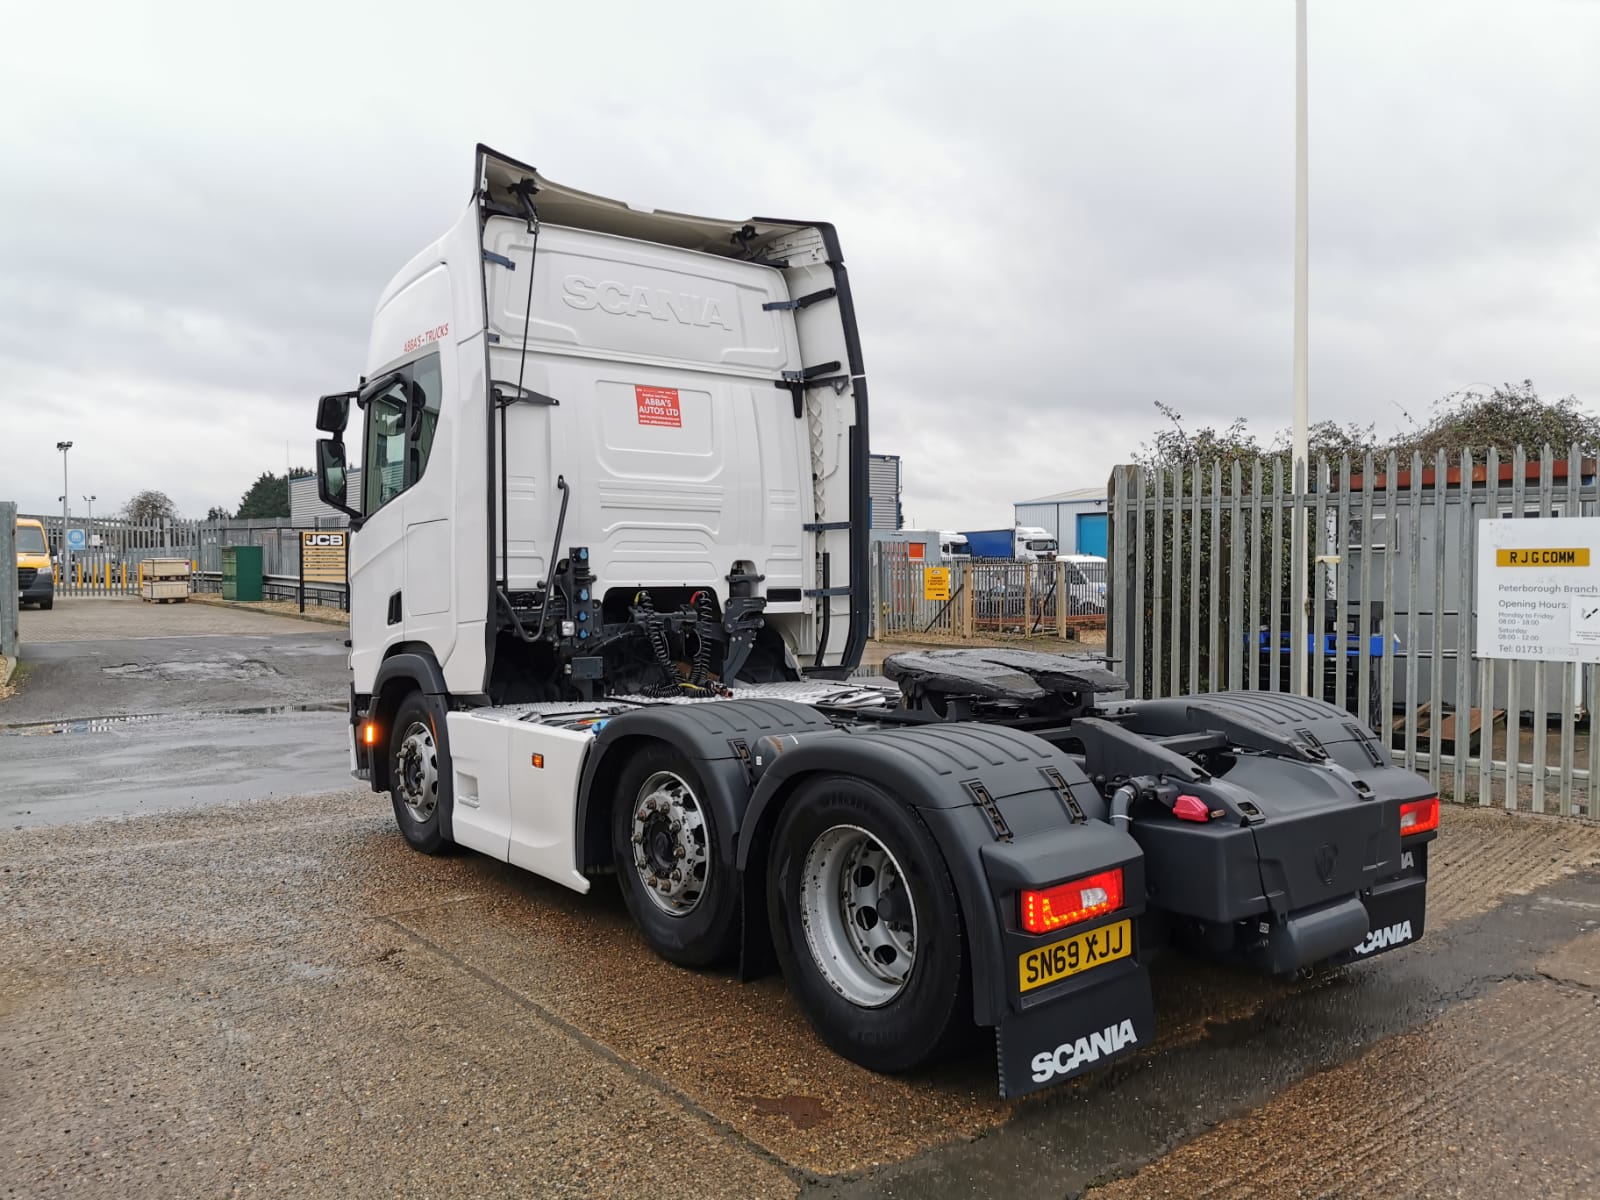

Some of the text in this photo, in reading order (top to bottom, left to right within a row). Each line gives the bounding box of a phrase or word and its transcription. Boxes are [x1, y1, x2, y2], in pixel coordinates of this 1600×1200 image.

[562, 274, 733, 332] SCANIA
[425, 323, 449, 343] TRUCKS
[645, 398, 672, 407] ABBA'S
[639, 405, 679, 416] AUTOS LTD
[305, 534, 343, 546] JCB
[1498, 584, 1598, 594] Peterborough Branch
[1498, 599, 1569, 609] Opening Hours:
[1498, 627, 1527, 635] Saturday
[1515, 645, 1543, 654] 01733
[1026, 926, 1123, 983] SN69 XJJ
[1031, 1018, 1138, 1083] SCANIA
